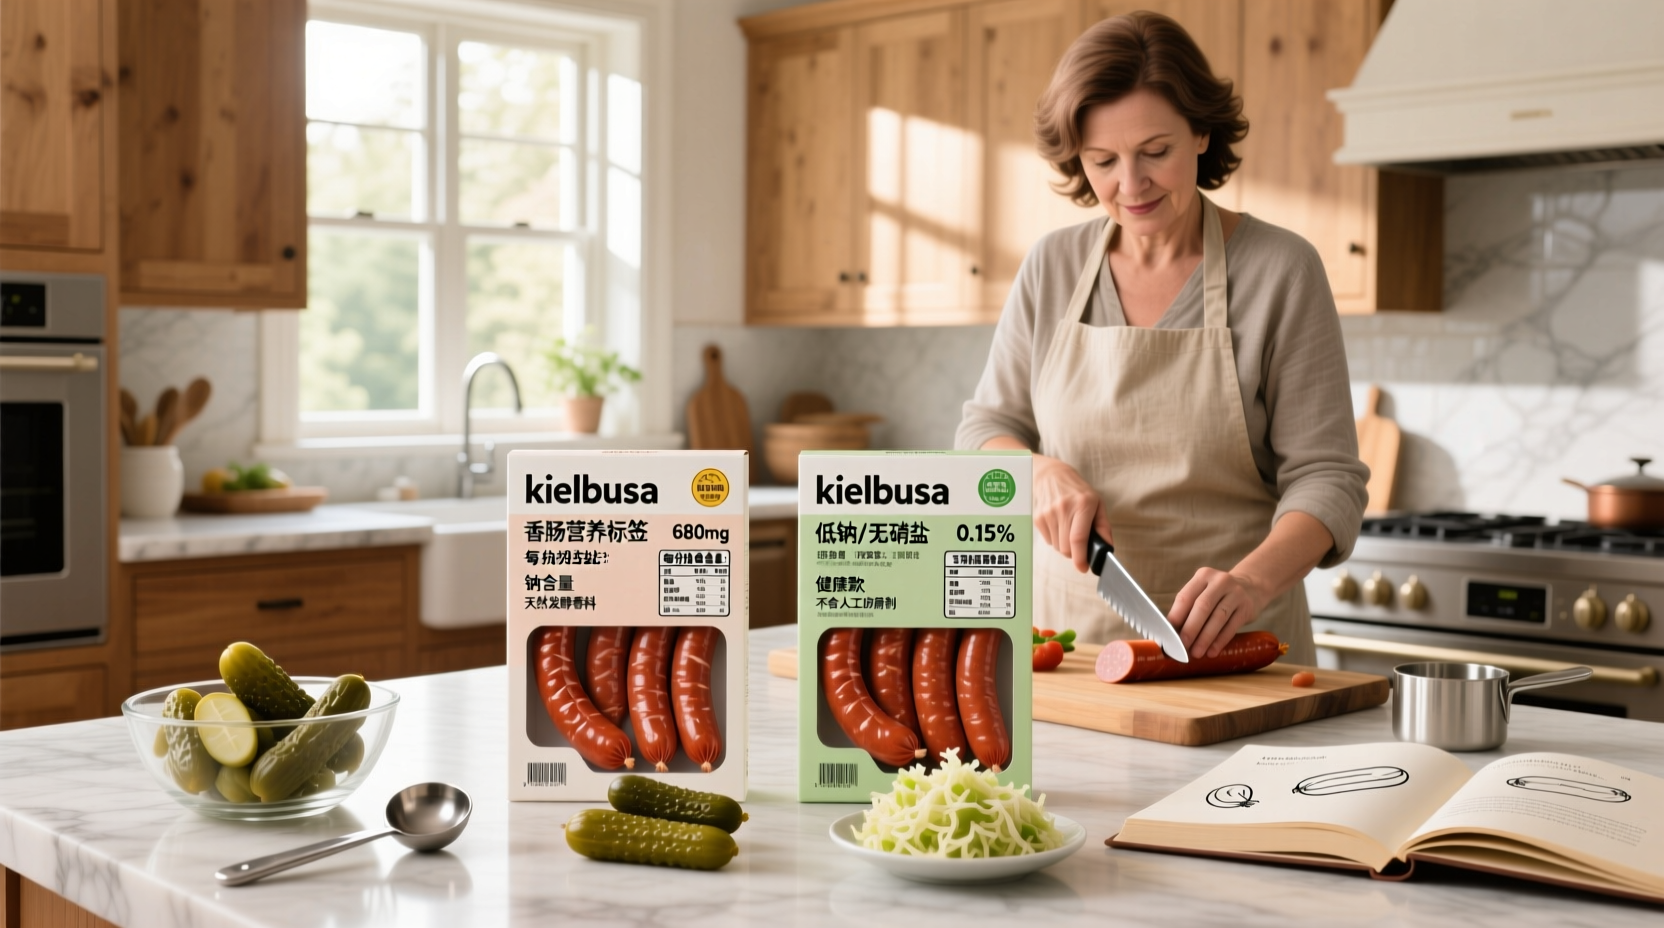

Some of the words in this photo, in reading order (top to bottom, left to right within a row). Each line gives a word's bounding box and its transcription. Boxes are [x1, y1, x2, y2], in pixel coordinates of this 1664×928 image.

[525, 474, 659, 504] kielbusa
[816, 475, 949, 505] kielbusa
[524, 519, 649, 543] 香肠营养标签
[672, 523, 730, 544] 680mg
[815, 521, 931, 545] 低钠/无硝盐
[956, 523, 1015, 543] 0.15%
